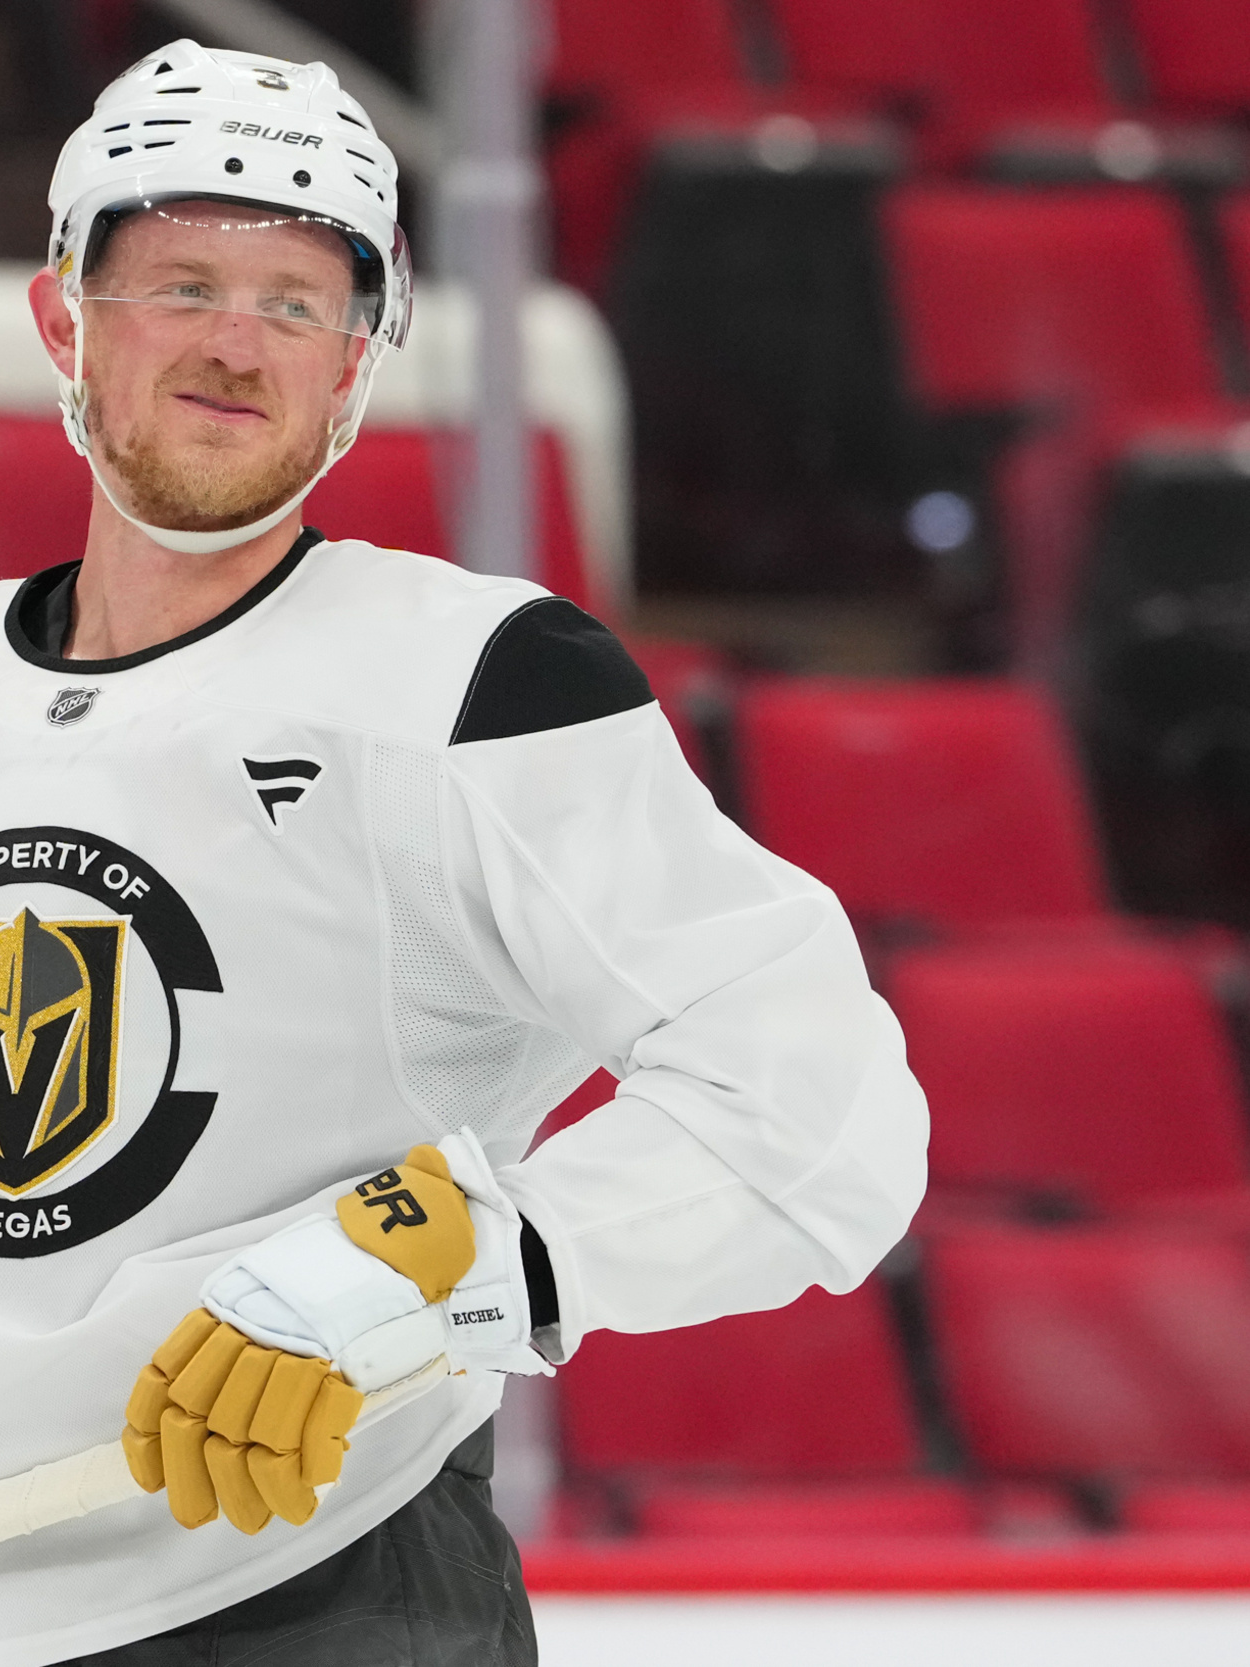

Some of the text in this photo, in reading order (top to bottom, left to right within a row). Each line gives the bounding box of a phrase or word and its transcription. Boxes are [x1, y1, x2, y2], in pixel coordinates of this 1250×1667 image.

[54, 693, 91, 717] NHL
[103, 863, 151, 900] OF
[451, 1306, 505, 1326] EICHEL
